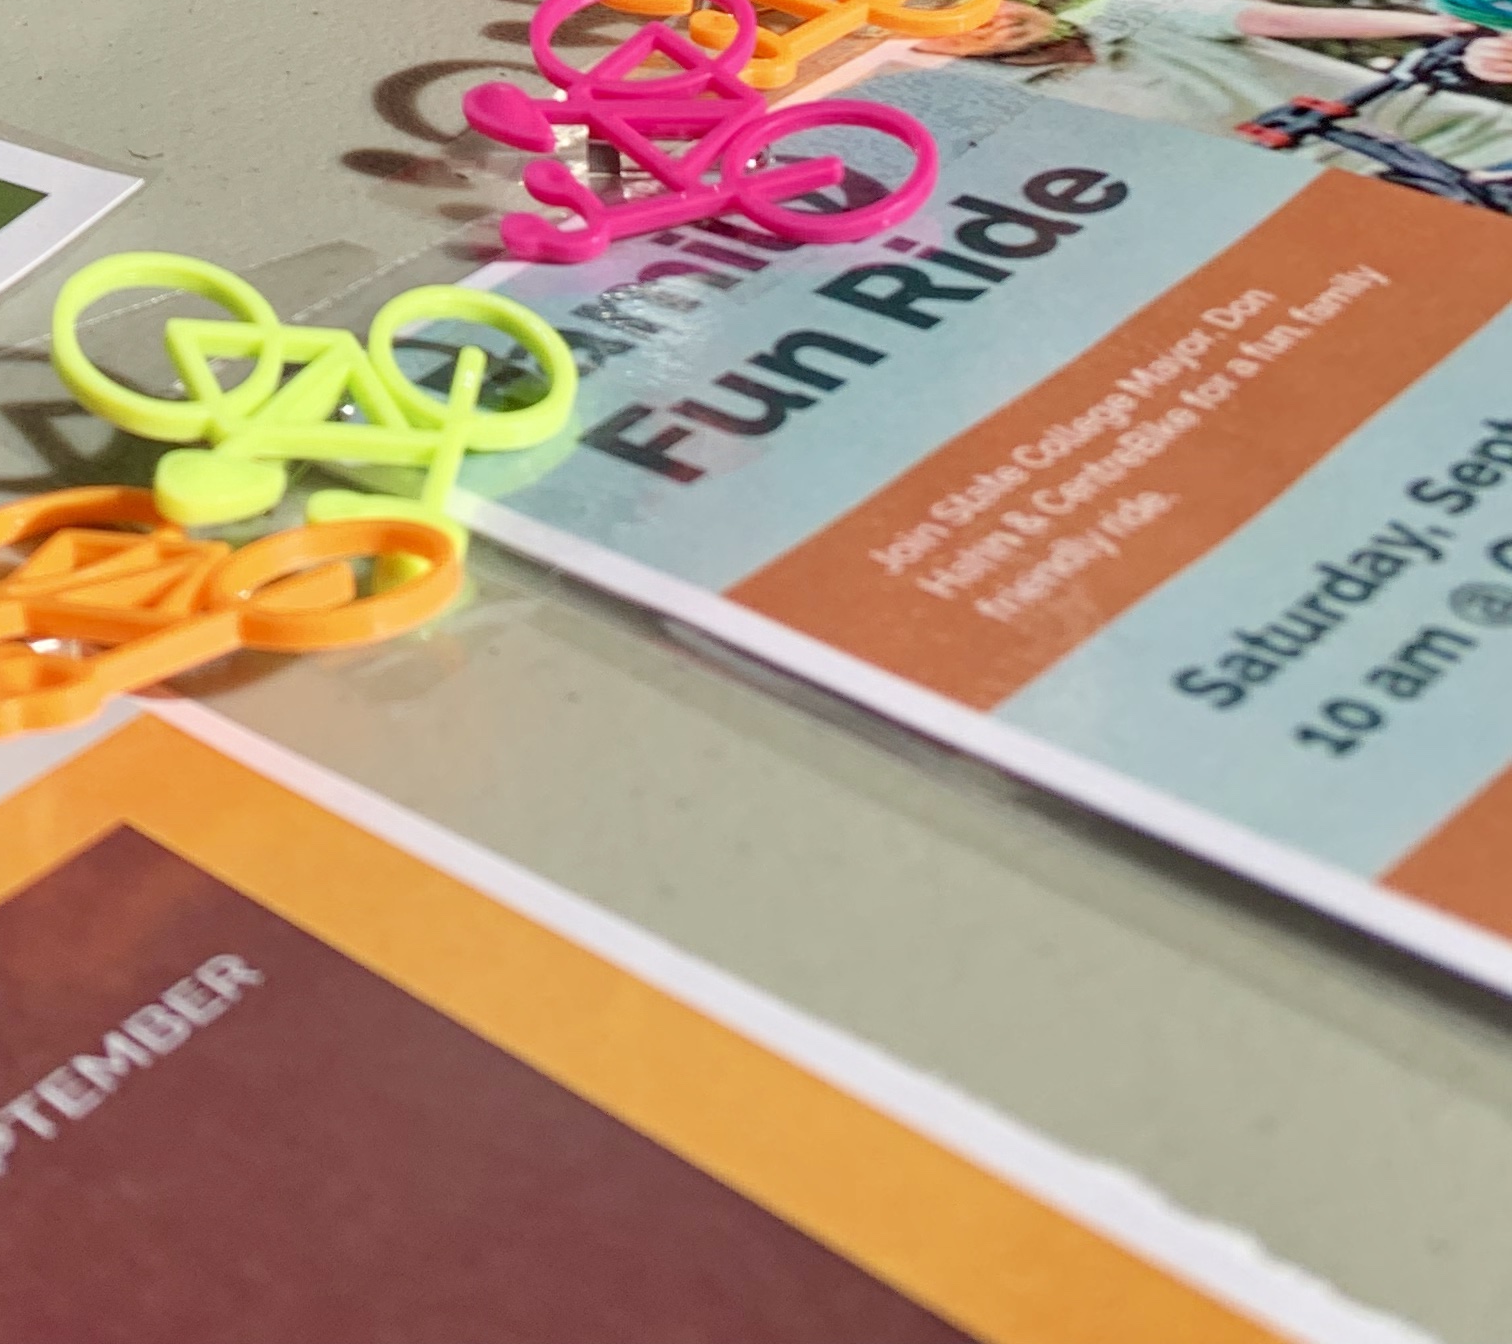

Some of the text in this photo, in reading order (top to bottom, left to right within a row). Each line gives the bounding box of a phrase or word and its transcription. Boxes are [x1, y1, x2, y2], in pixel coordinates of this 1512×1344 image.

[581, 329, 888, 484] Fun
[816, 166, 1130, 330] Ride
[869, 521, 952, 575] Join
[930, 465, 1030, 526] State
[1011, 392, 1138, 470] College
[1201, 288, 1278, 332] Don
[1032, 407, 1201, 514] CentreBike
[1180, 373, 1238, 410] for
[1226, 358, 1261, 379] a
[1289, 265, 1390, 327] family
[975, 530, 1120, 621] friendly
[1171, 519, 1456, 709] Saturday,
[1293, 624, 1479, 758] 10 am
